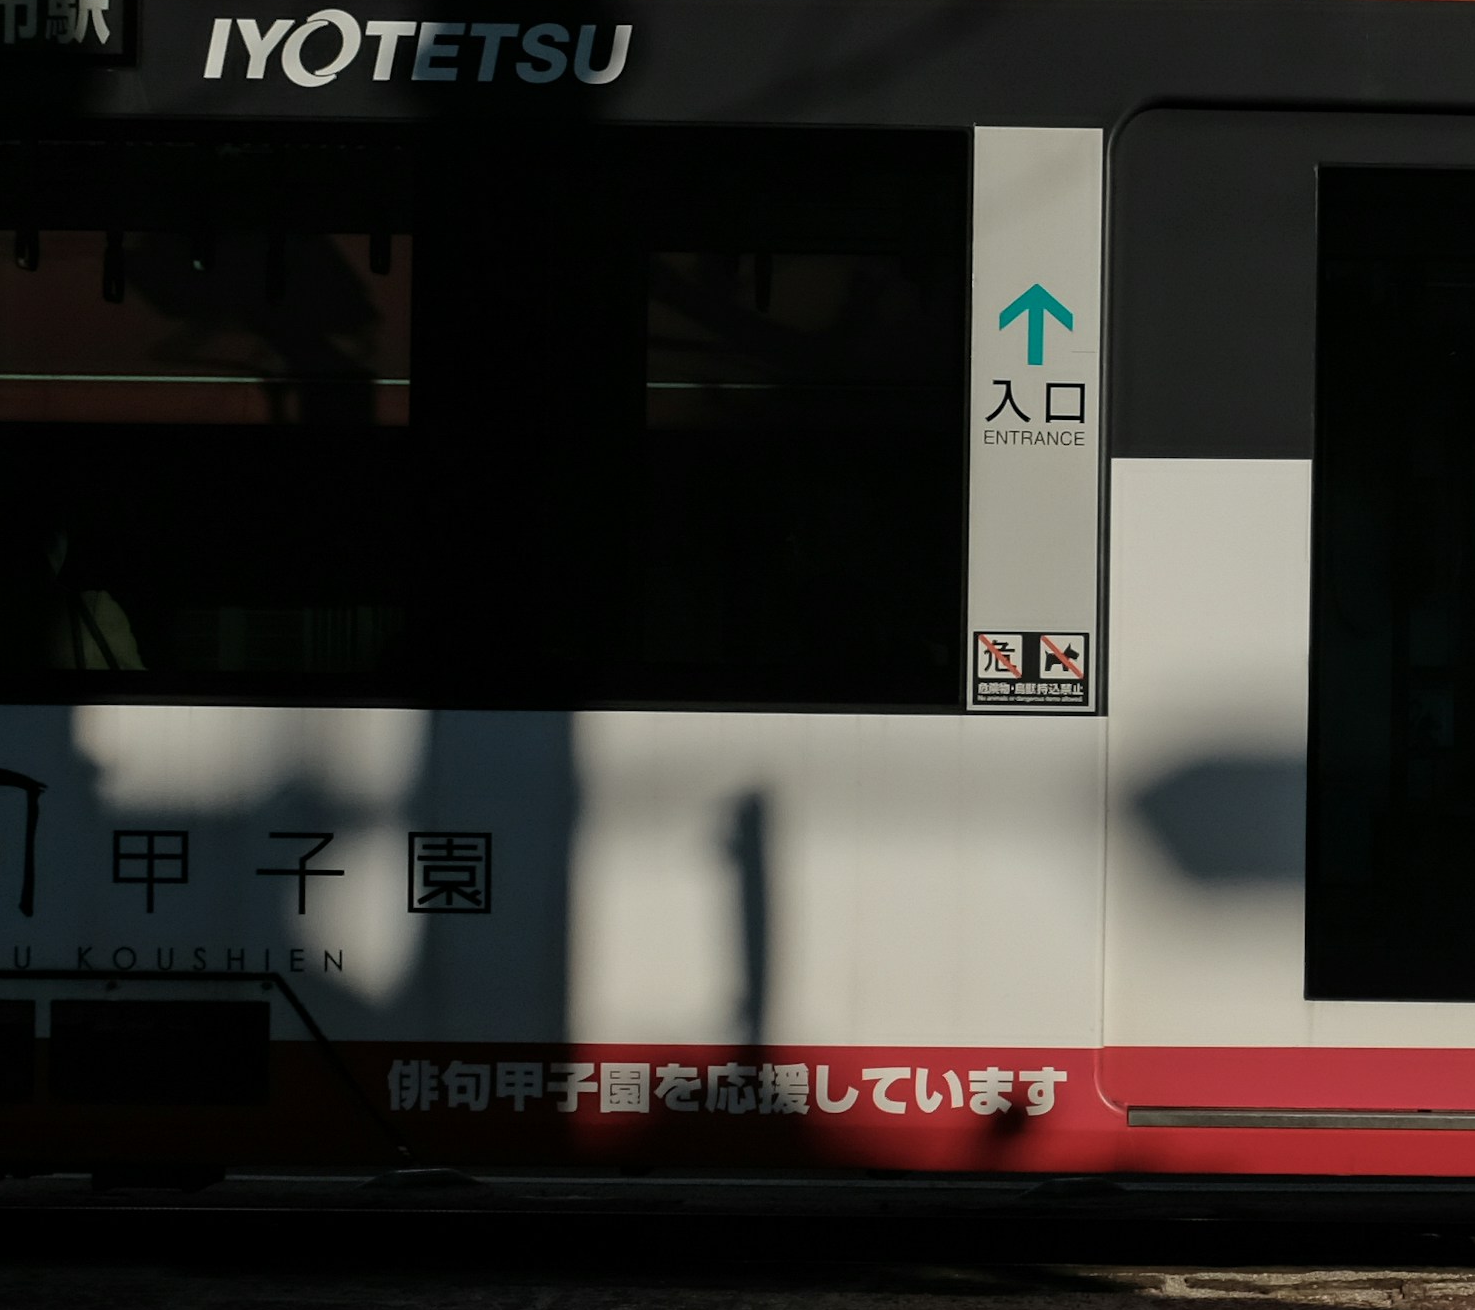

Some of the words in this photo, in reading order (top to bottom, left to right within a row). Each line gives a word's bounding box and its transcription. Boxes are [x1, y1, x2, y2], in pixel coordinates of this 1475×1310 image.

[202, 7, 634, 88] IYOTETSU
[984, 379, 1086, 425] 入口
[983, 429, 1086, 447] ENTRANCE
[77, 945, 345, 974] KOUSHIEN
[386, 1057, 1068, 1119] 俳句甲子園を応援しています
